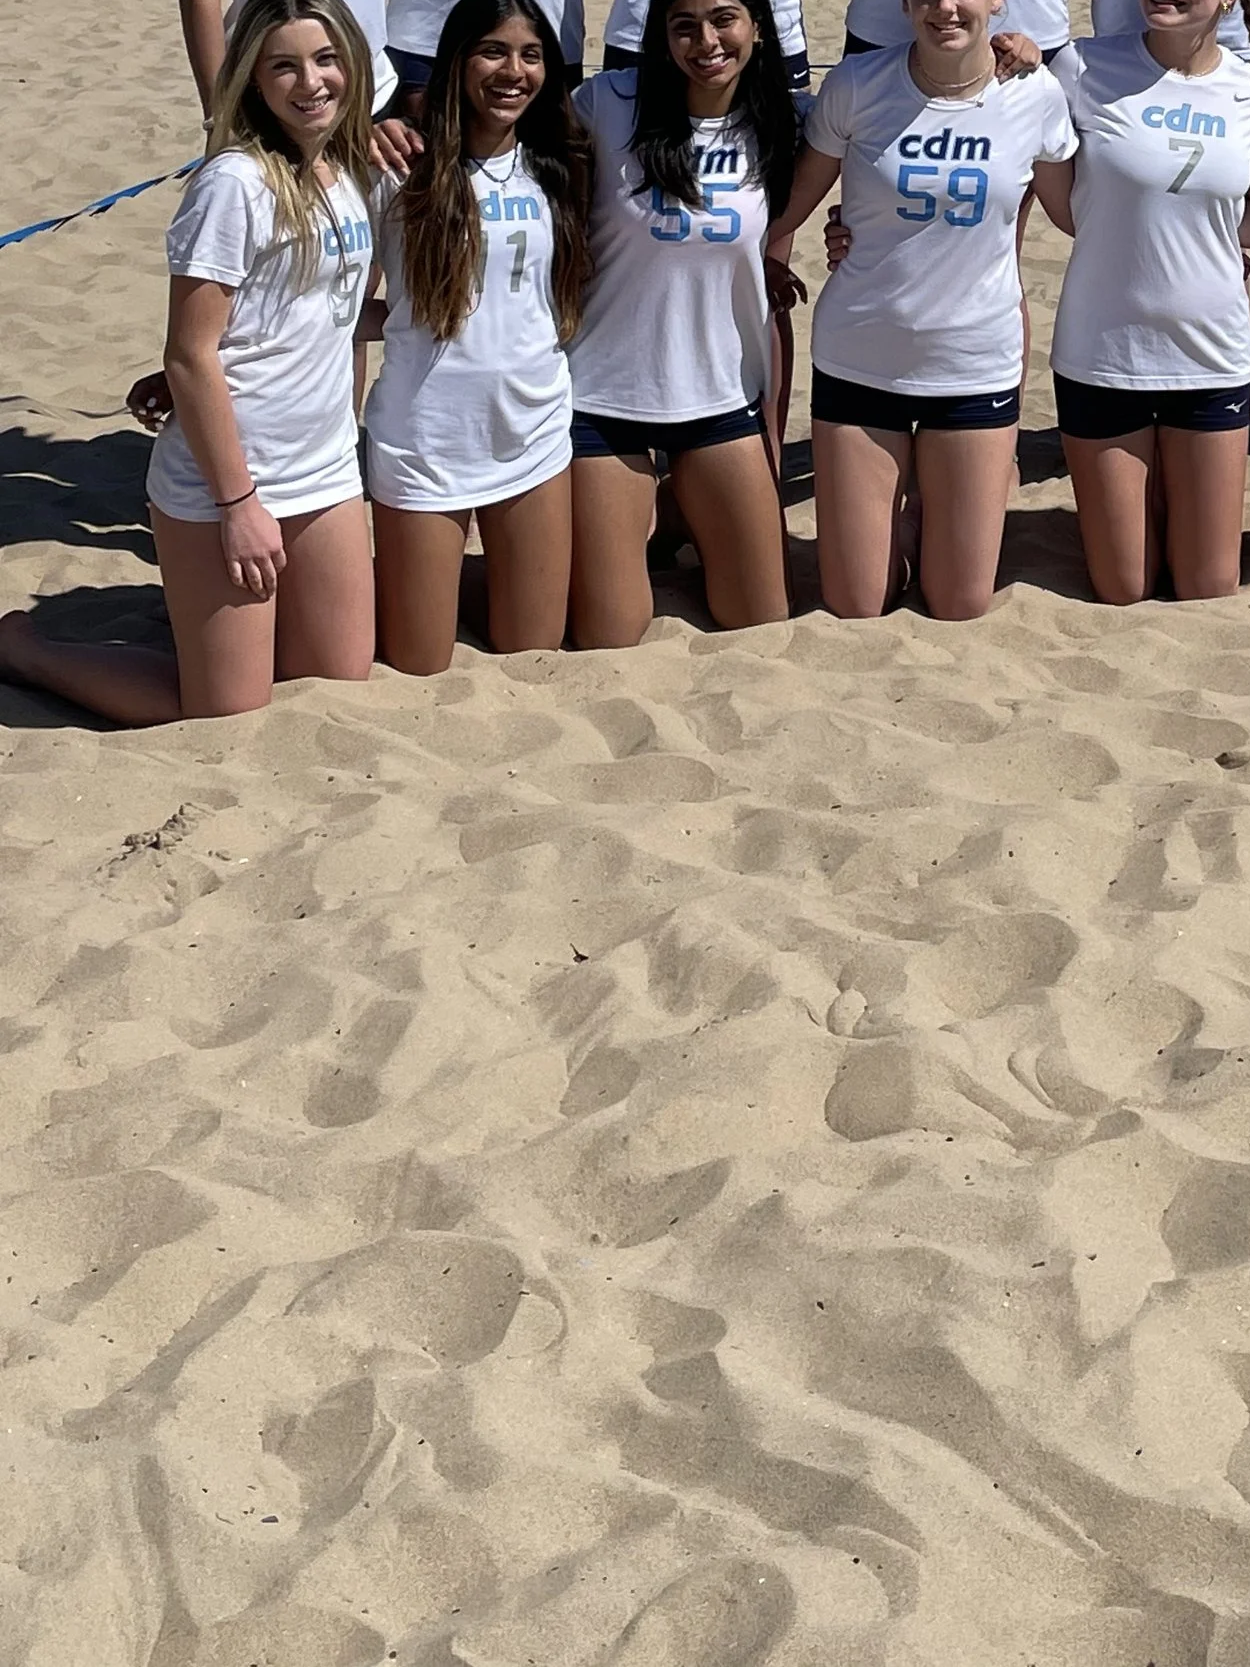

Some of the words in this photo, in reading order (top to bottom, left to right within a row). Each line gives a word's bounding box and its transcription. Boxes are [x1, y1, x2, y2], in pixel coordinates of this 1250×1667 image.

[899, 128, 990, 162] cdm
[1141, 103, 1226, 138] cdm
[1166, 138, 1205, 195] 7
[478, 190, 540, 221] dm
[650, 183, 741, 243] 55
[897, 165, 988, 227] 59
[331, 263, 363, 328] 9
